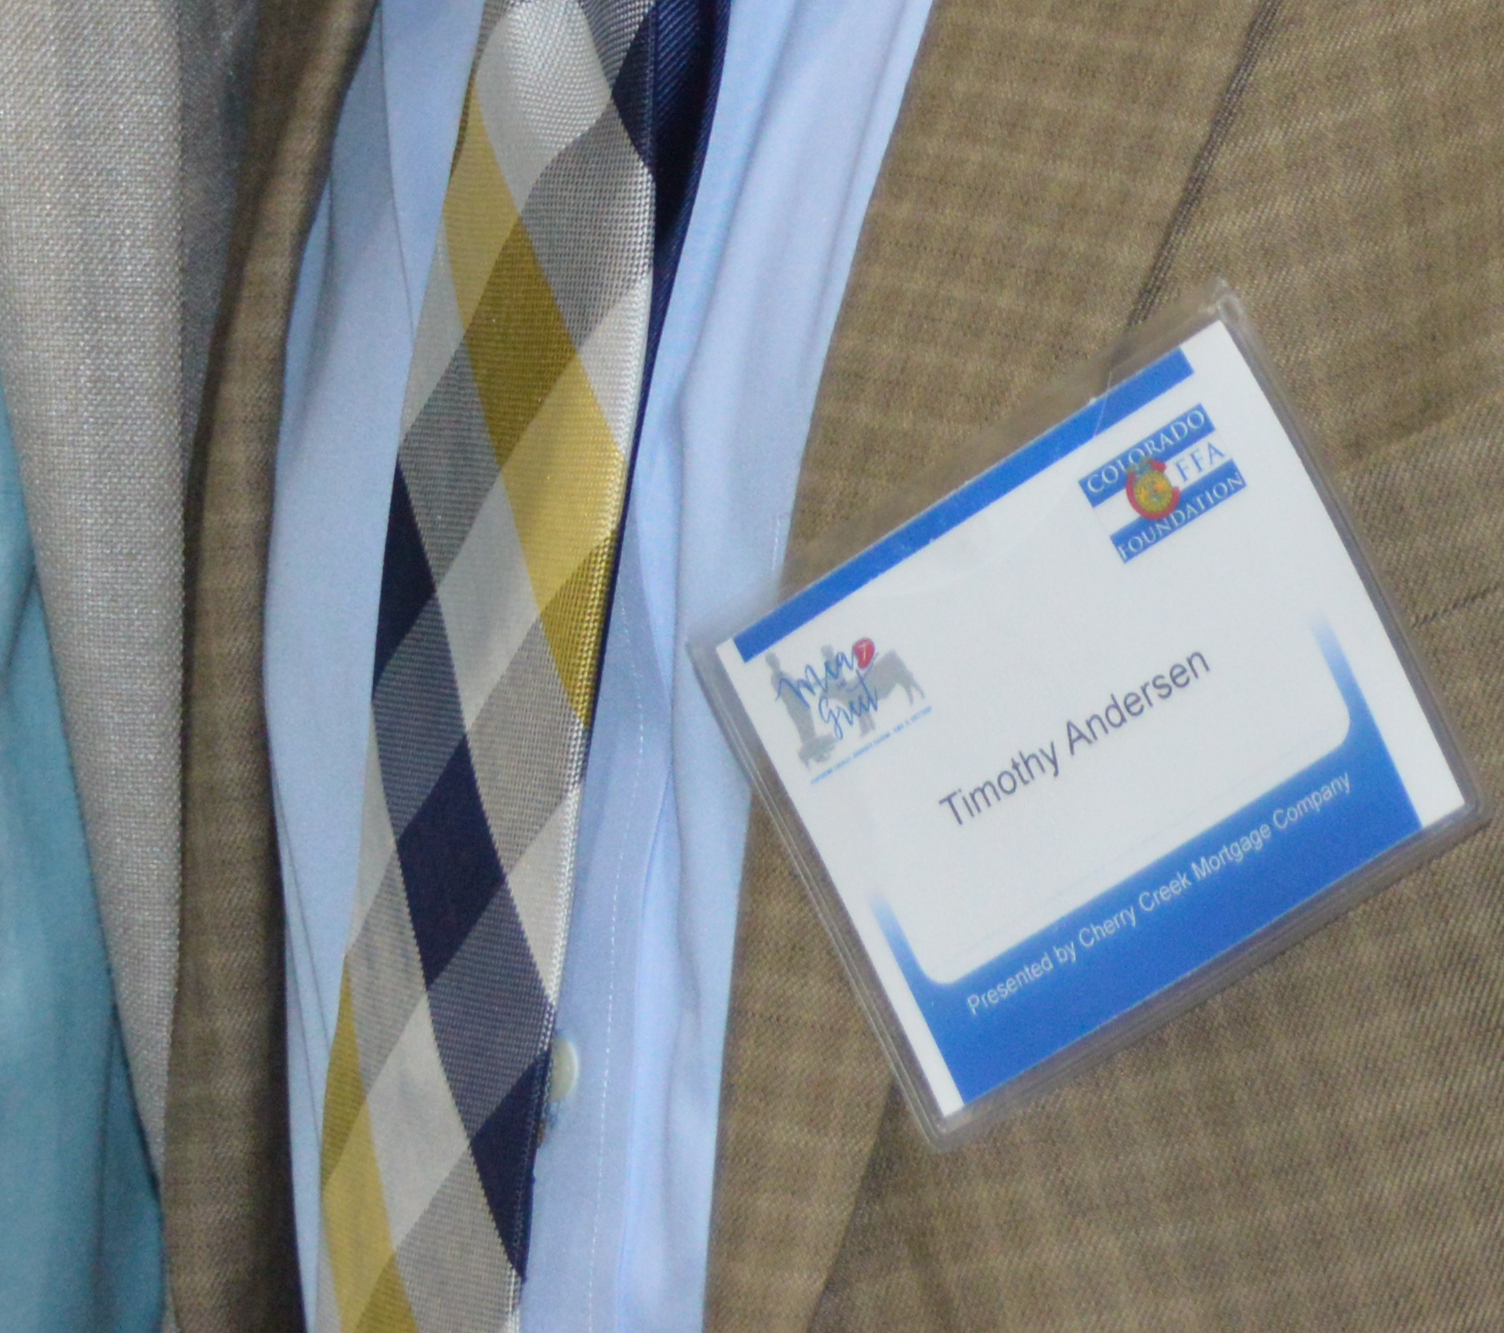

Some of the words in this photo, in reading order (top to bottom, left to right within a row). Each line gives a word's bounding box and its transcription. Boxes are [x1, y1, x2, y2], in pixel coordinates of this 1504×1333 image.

[1087, 409, 1205, 493] COLORADO
[1175, 441, 1226, 483] FFA
[1117, 471, 1245, 560] FOUNDATION
[937, 740, 1060, 826] Timothy
[1065, 650, 1211, 757] Andersen
[966, 952, 1054, 1016] Presented
[1052, 939, 1079, 965] by
[1078, 905, 1138, 949] Cherry
[1137, 869, 1193, 914] Creek
[1191, 820, 1273, 882] Mortgage
[1271, 771, 1352, 832] Company
